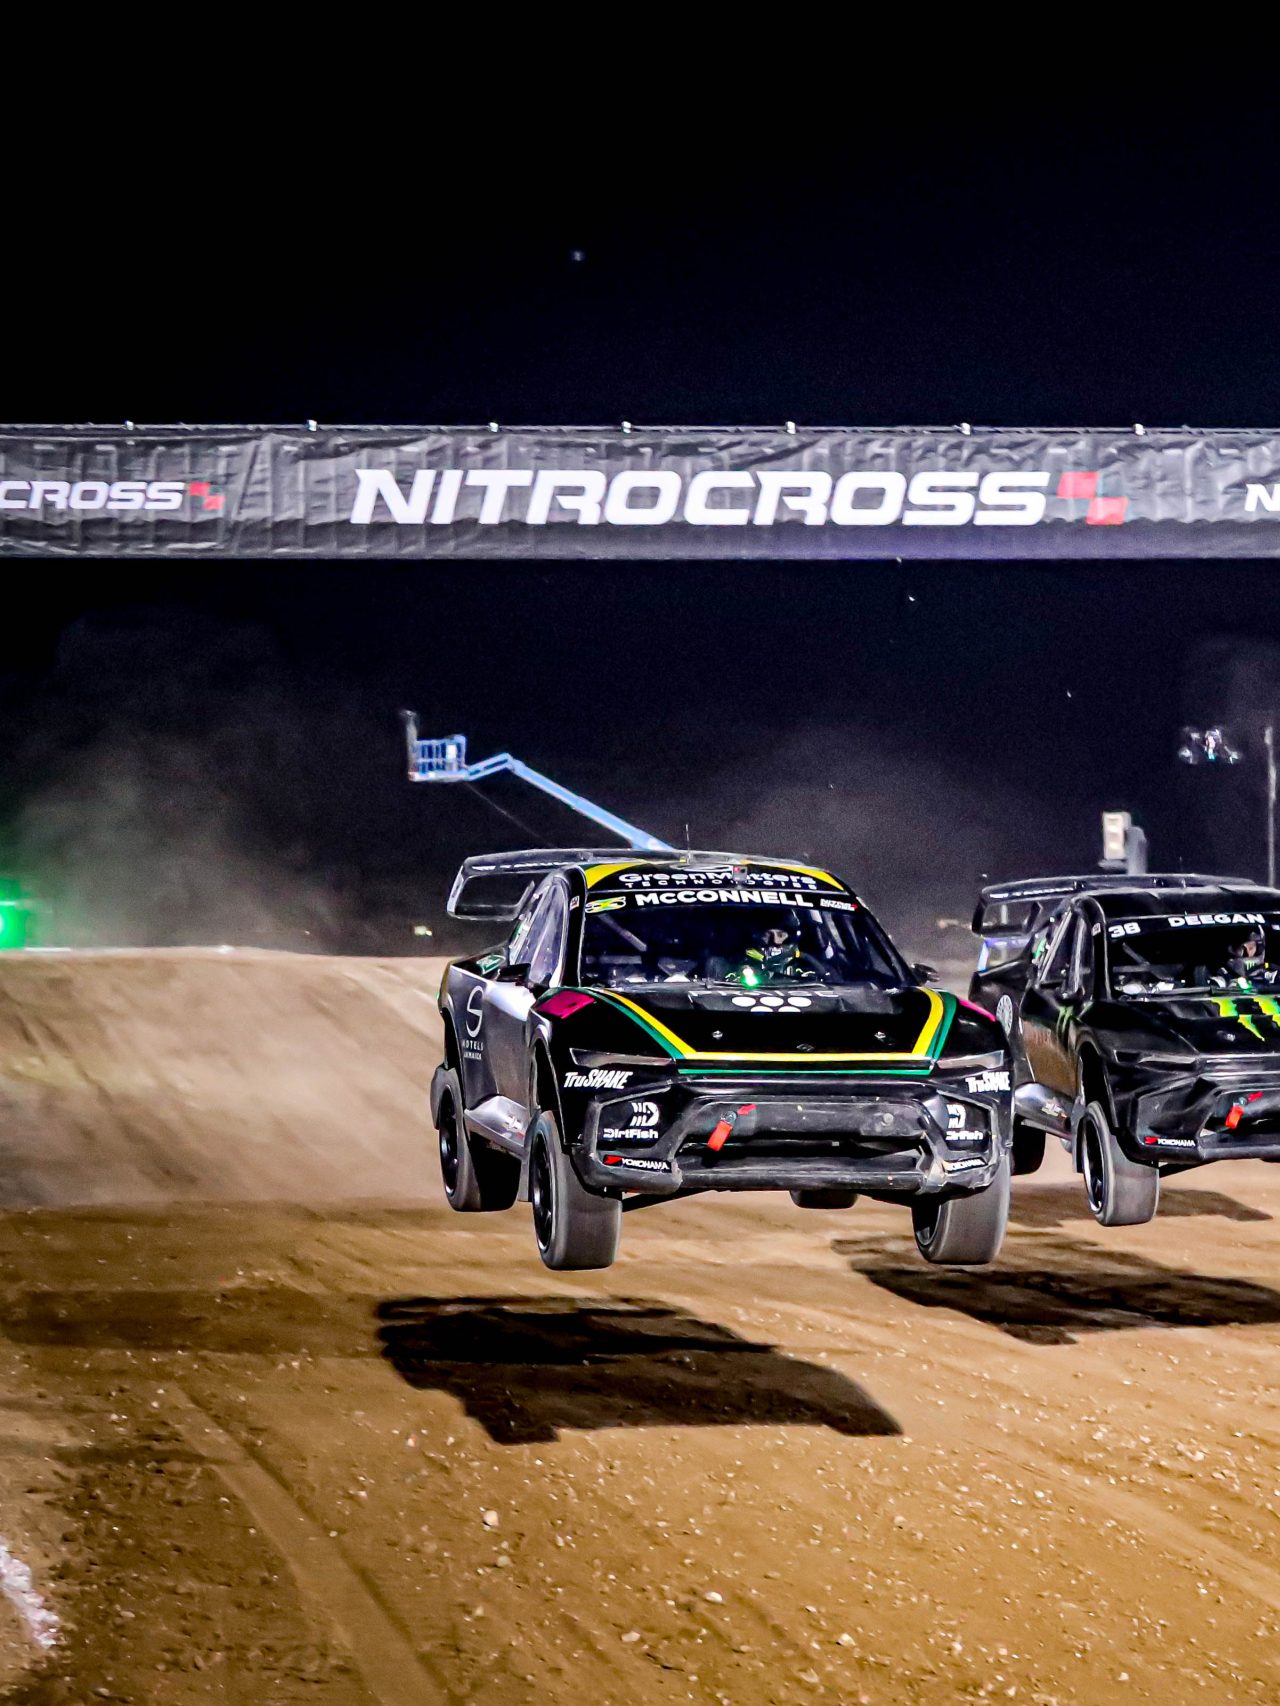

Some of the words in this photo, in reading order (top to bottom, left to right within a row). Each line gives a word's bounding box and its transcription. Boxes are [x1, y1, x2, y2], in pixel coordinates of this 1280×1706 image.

[350, 468, 1051, 527] NITROCROSS
[1168, 913, 1266, 928] DEEGAN
[1108, 922, 1141, 938] 38
[563, 1069, 634, 1090] TruSHAKE
[603, 1129, 659, 1139] DirtFish
[1157, 1139, 1196, 1147] YOKOHAMA
[621, 1158, 670, 1170] YOKOHAMA
